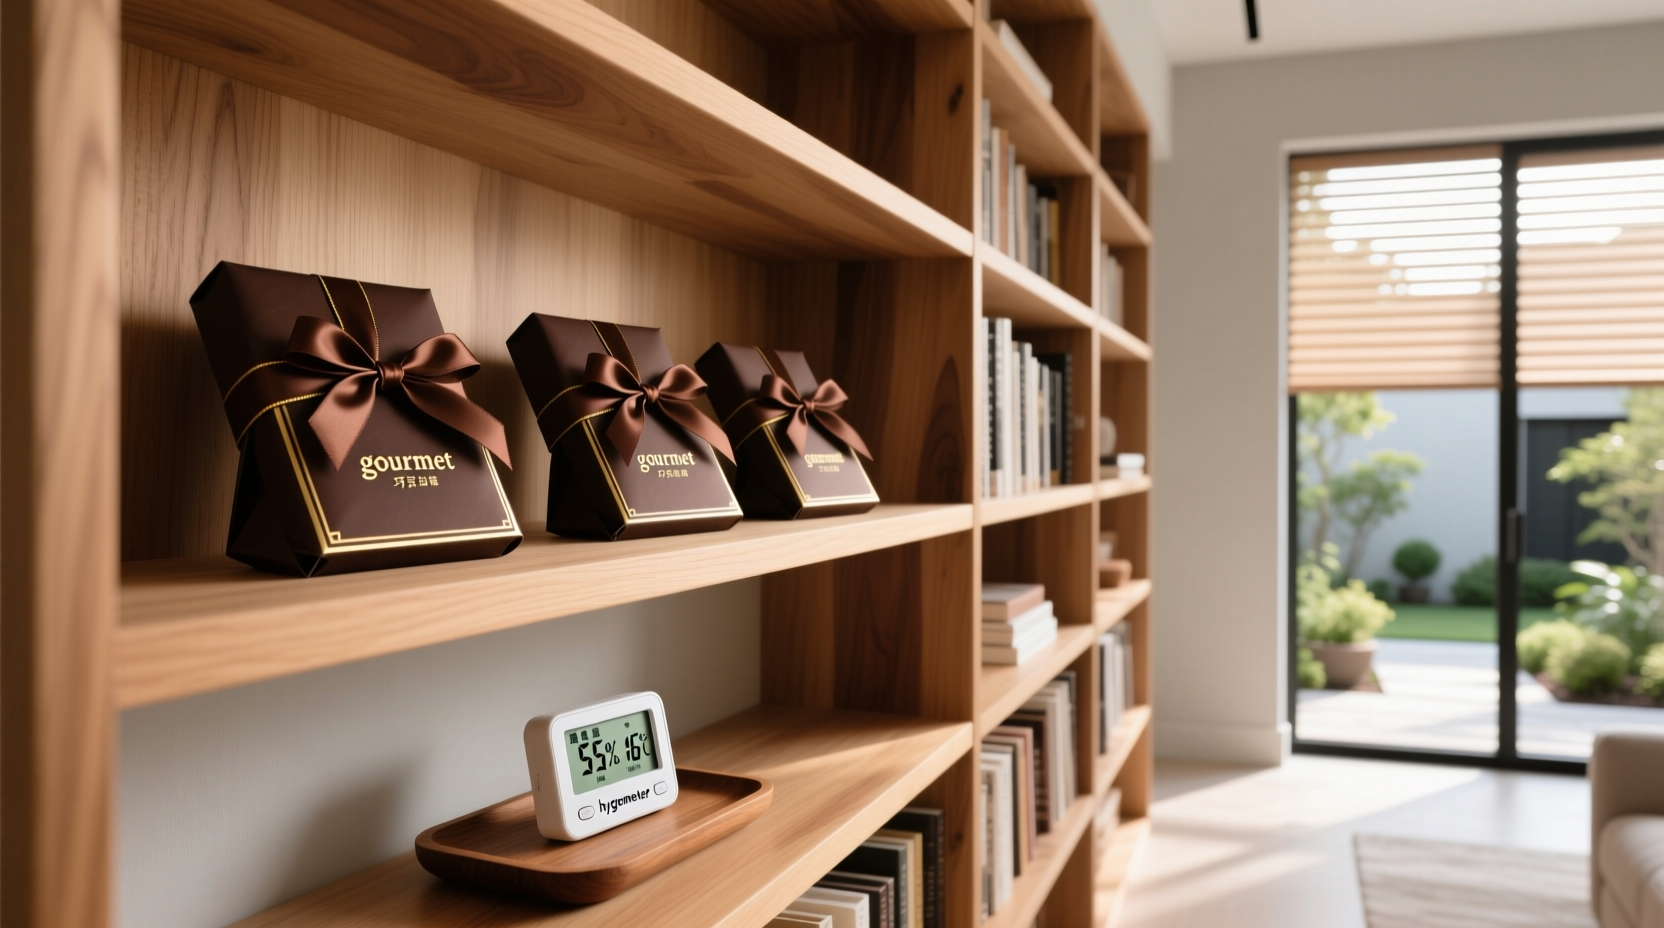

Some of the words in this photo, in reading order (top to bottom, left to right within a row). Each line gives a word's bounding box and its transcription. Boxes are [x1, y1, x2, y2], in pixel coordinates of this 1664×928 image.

[360, 452, 455, 480] gourmet
[637, 451, 696, 473] gourmet
[578, 739, 620, 776] 55%
